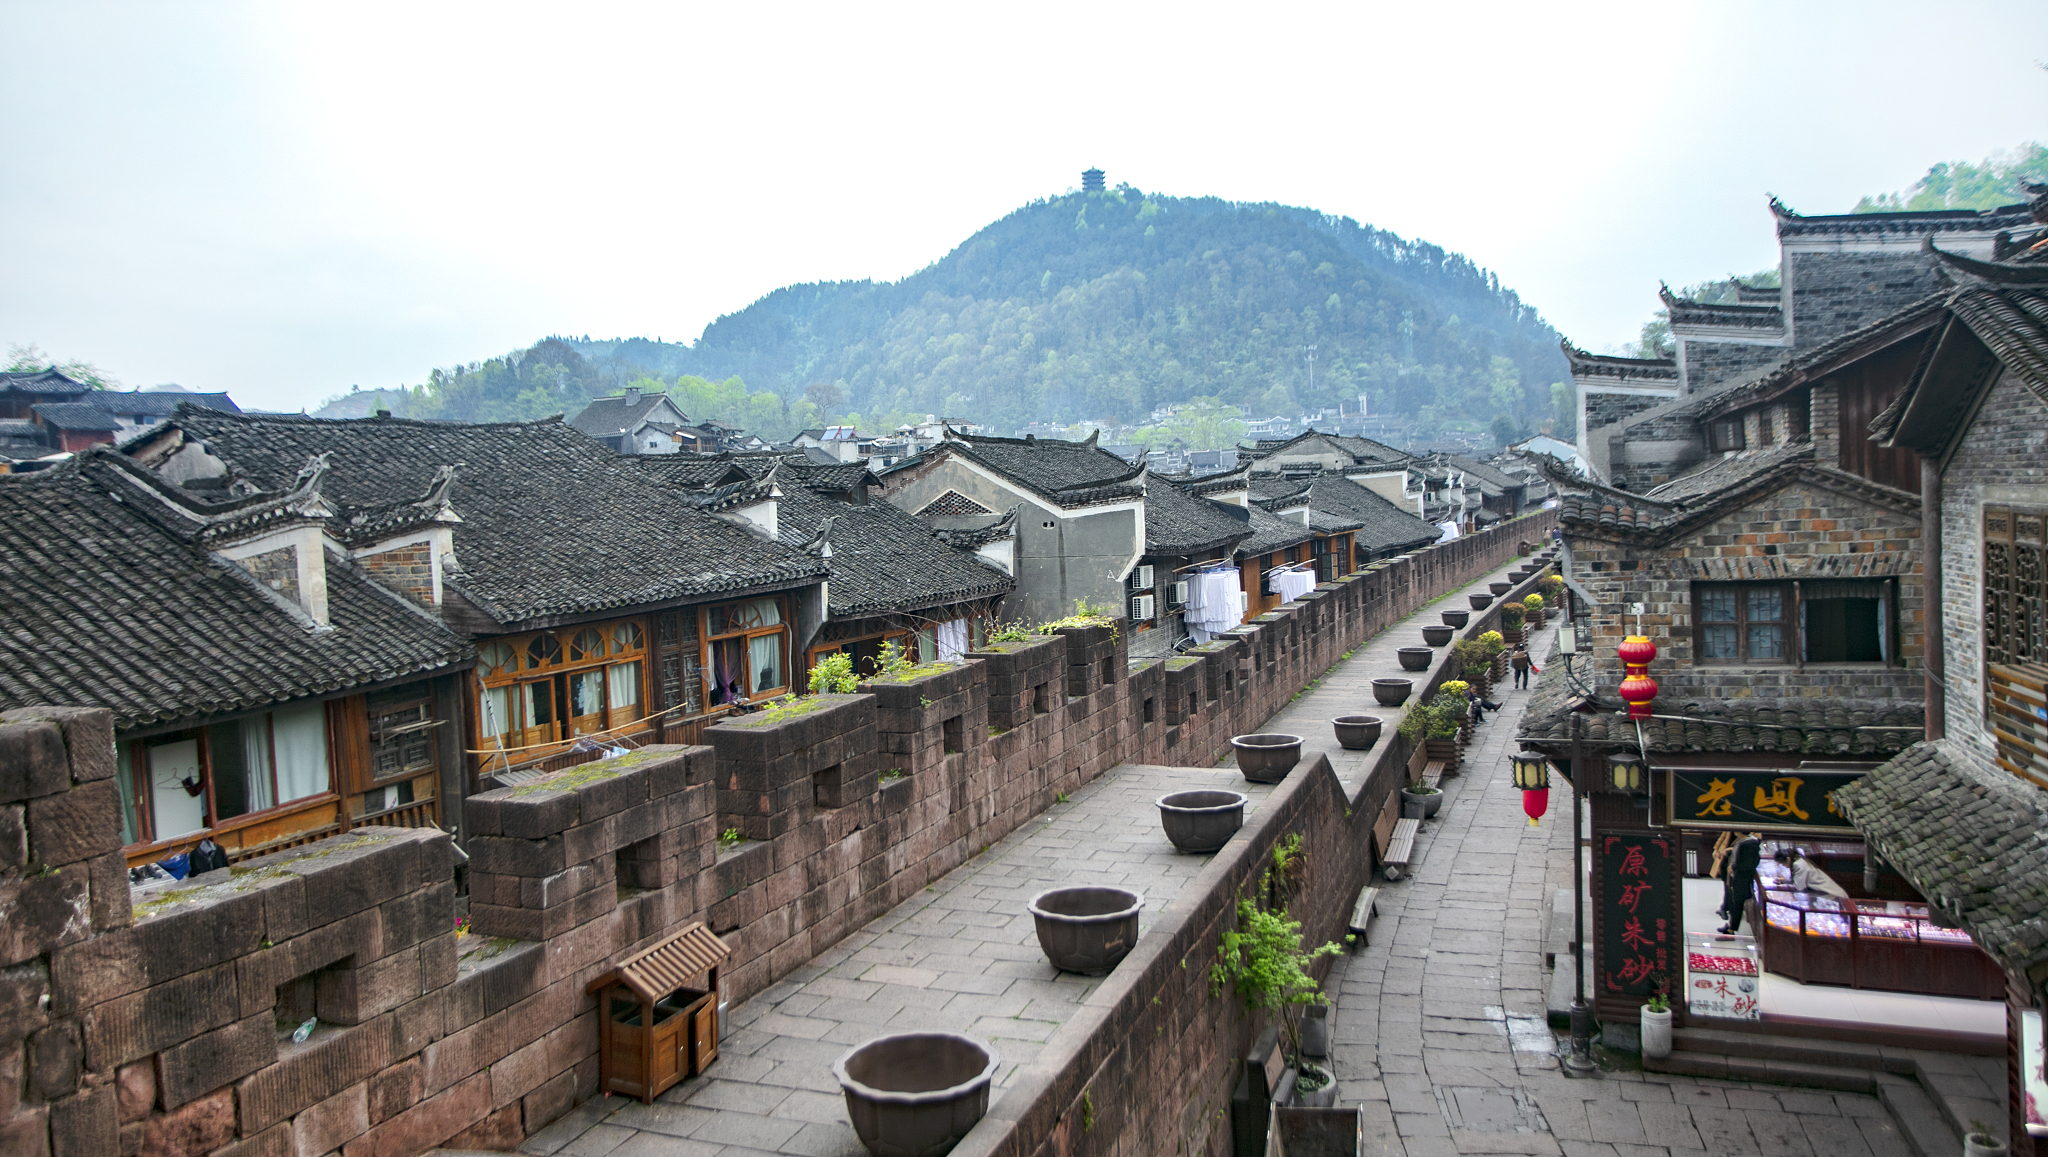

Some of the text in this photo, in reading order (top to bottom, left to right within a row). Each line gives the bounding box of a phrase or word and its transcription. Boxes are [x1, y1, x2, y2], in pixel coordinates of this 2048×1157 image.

[1617, 844, 1656, 986] 原矿朱砂
[1713, 975, 1757, 1016] 朱砂
